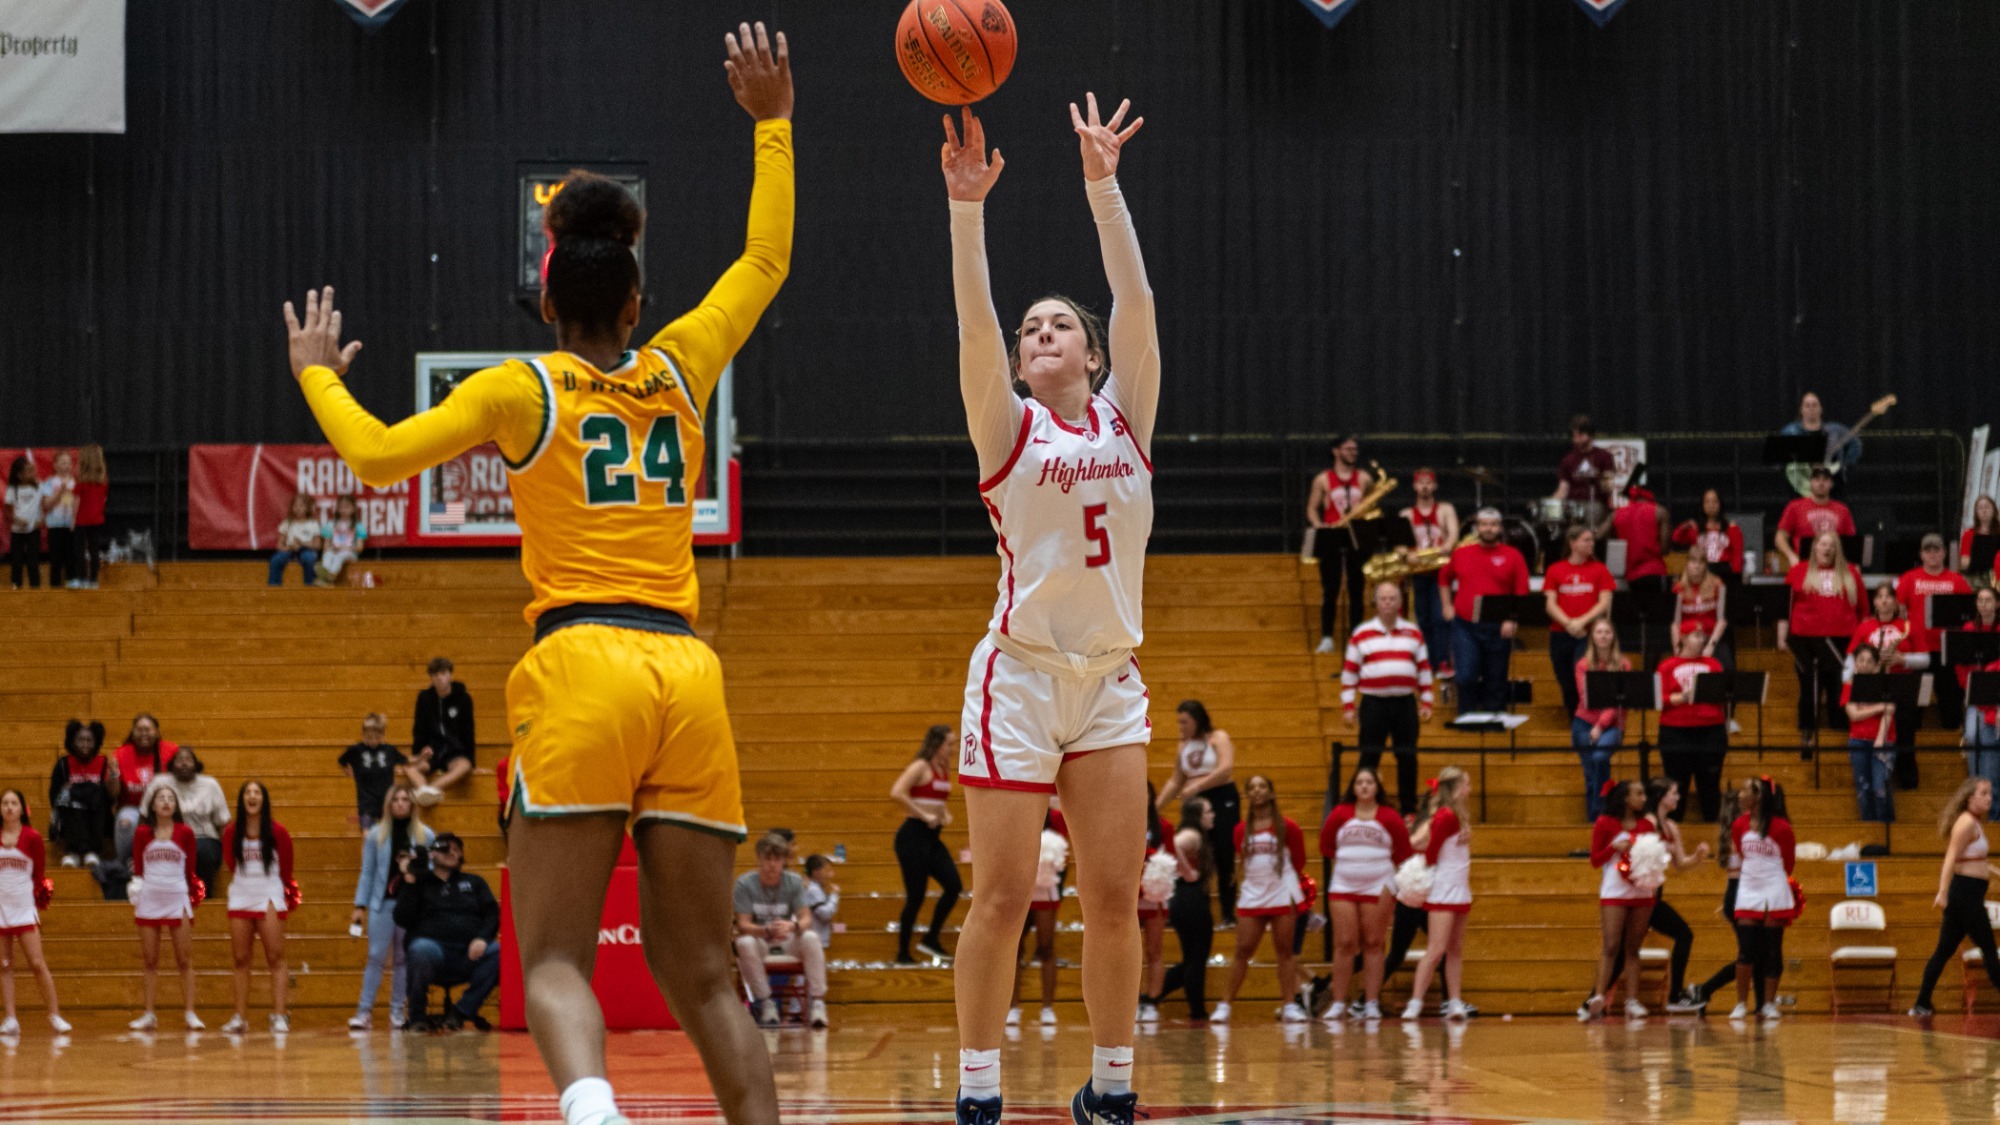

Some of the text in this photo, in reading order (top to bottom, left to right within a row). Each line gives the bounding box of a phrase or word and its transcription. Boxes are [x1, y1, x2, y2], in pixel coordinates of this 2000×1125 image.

[0, 31, 78, 58] Property
[926, 4, 983, 80] SPALDING
[580, 413, 687, 507] 24
[1083, 502, 1111, 568] 5
[1845, 906, 1869, 922] RU
